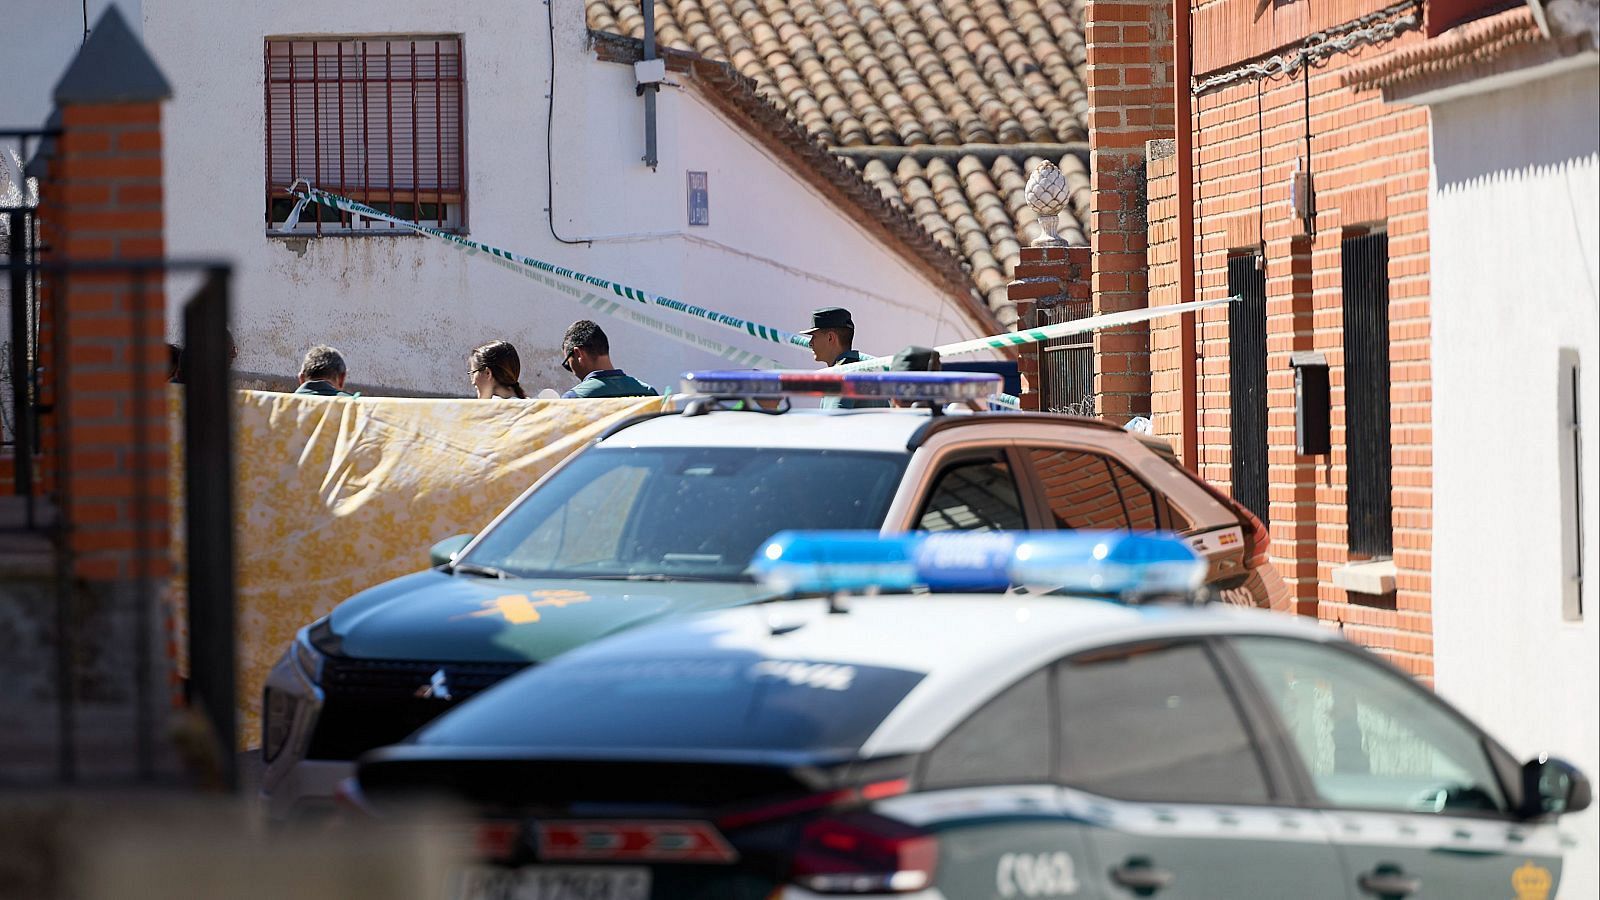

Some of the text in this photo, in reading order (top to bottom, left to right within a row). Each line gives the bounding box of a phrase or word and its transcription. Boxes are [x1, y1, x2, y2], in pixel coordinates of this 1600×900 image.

[523, 256, 610, 289] GUARDIA CIVIL NO PASAR
[655, 296, 744, 329] GUARDIA CIVIL NO PASAR
